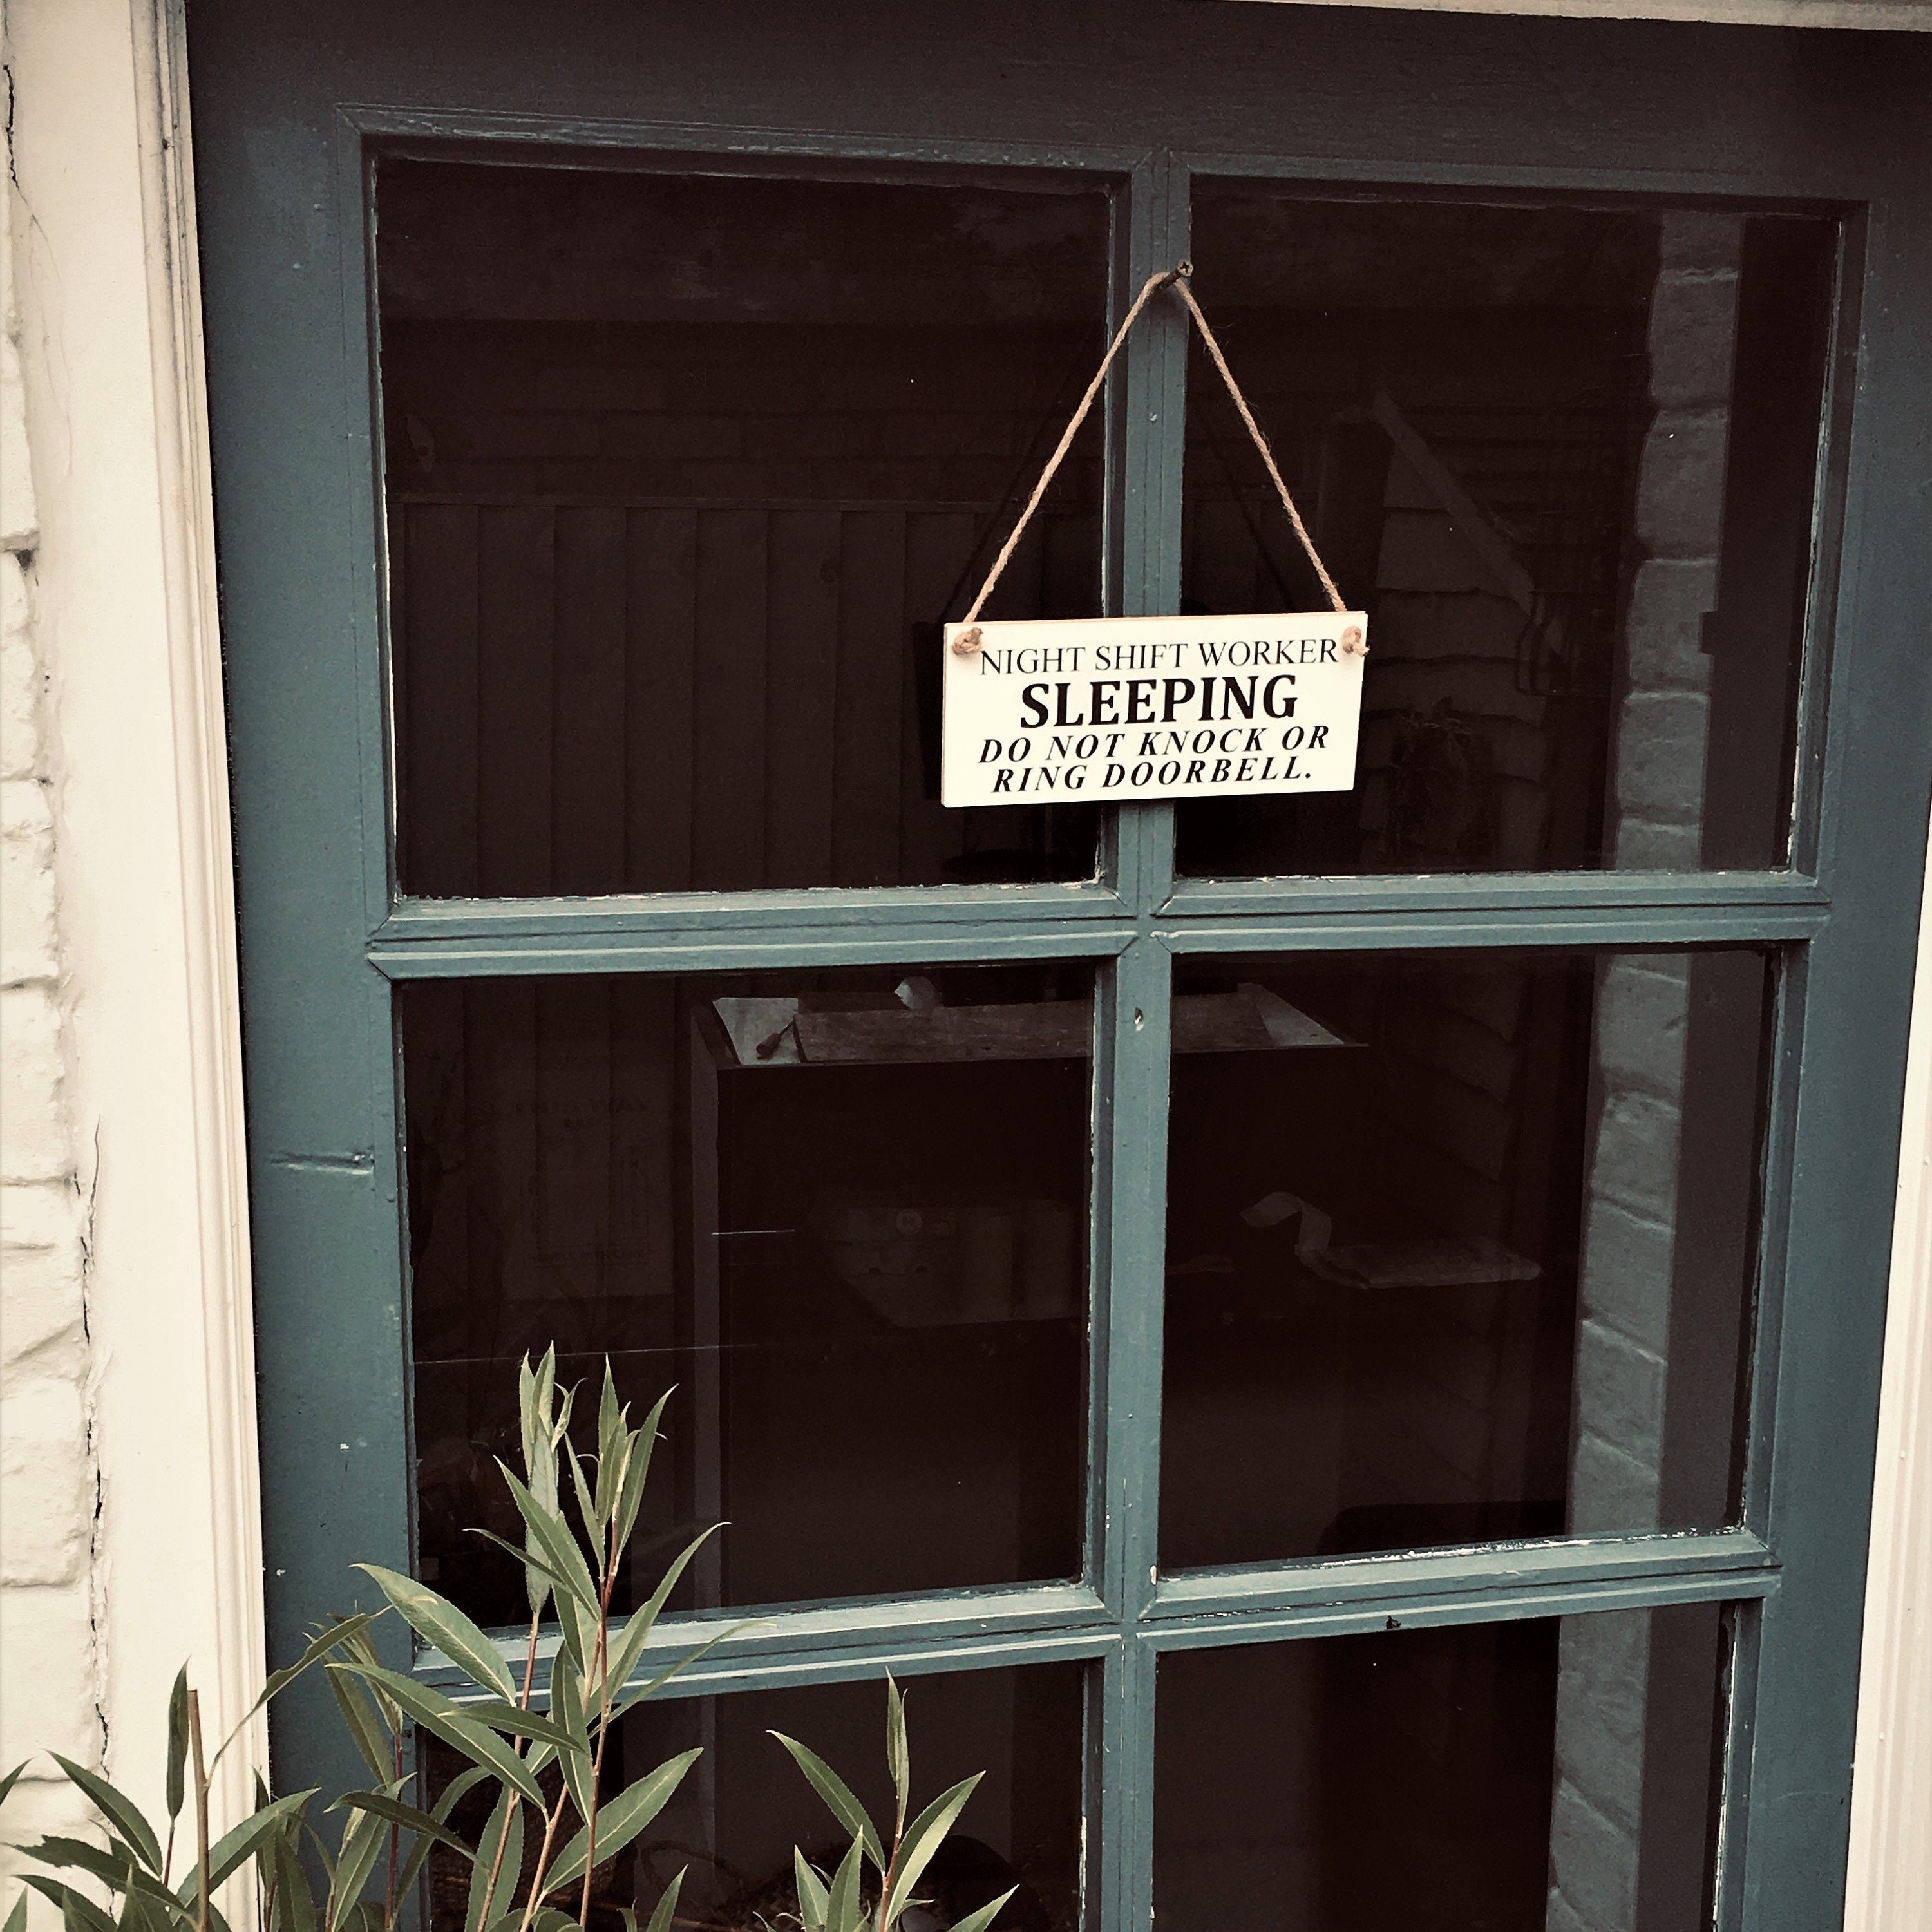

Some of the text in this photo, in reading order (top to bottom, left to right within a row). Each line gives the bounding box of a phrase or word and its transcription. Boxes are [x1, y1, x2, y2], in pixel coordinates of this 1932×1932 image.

[981, 639, 1339, 675] NIGHT SHIFT WORKER
[1020, 674, 1298, 728] SLEEPING
[978, 725, 1329, 763] DO NOT KNOCK OR
[992, 756, 1311, 793] RING DOORBELL.
